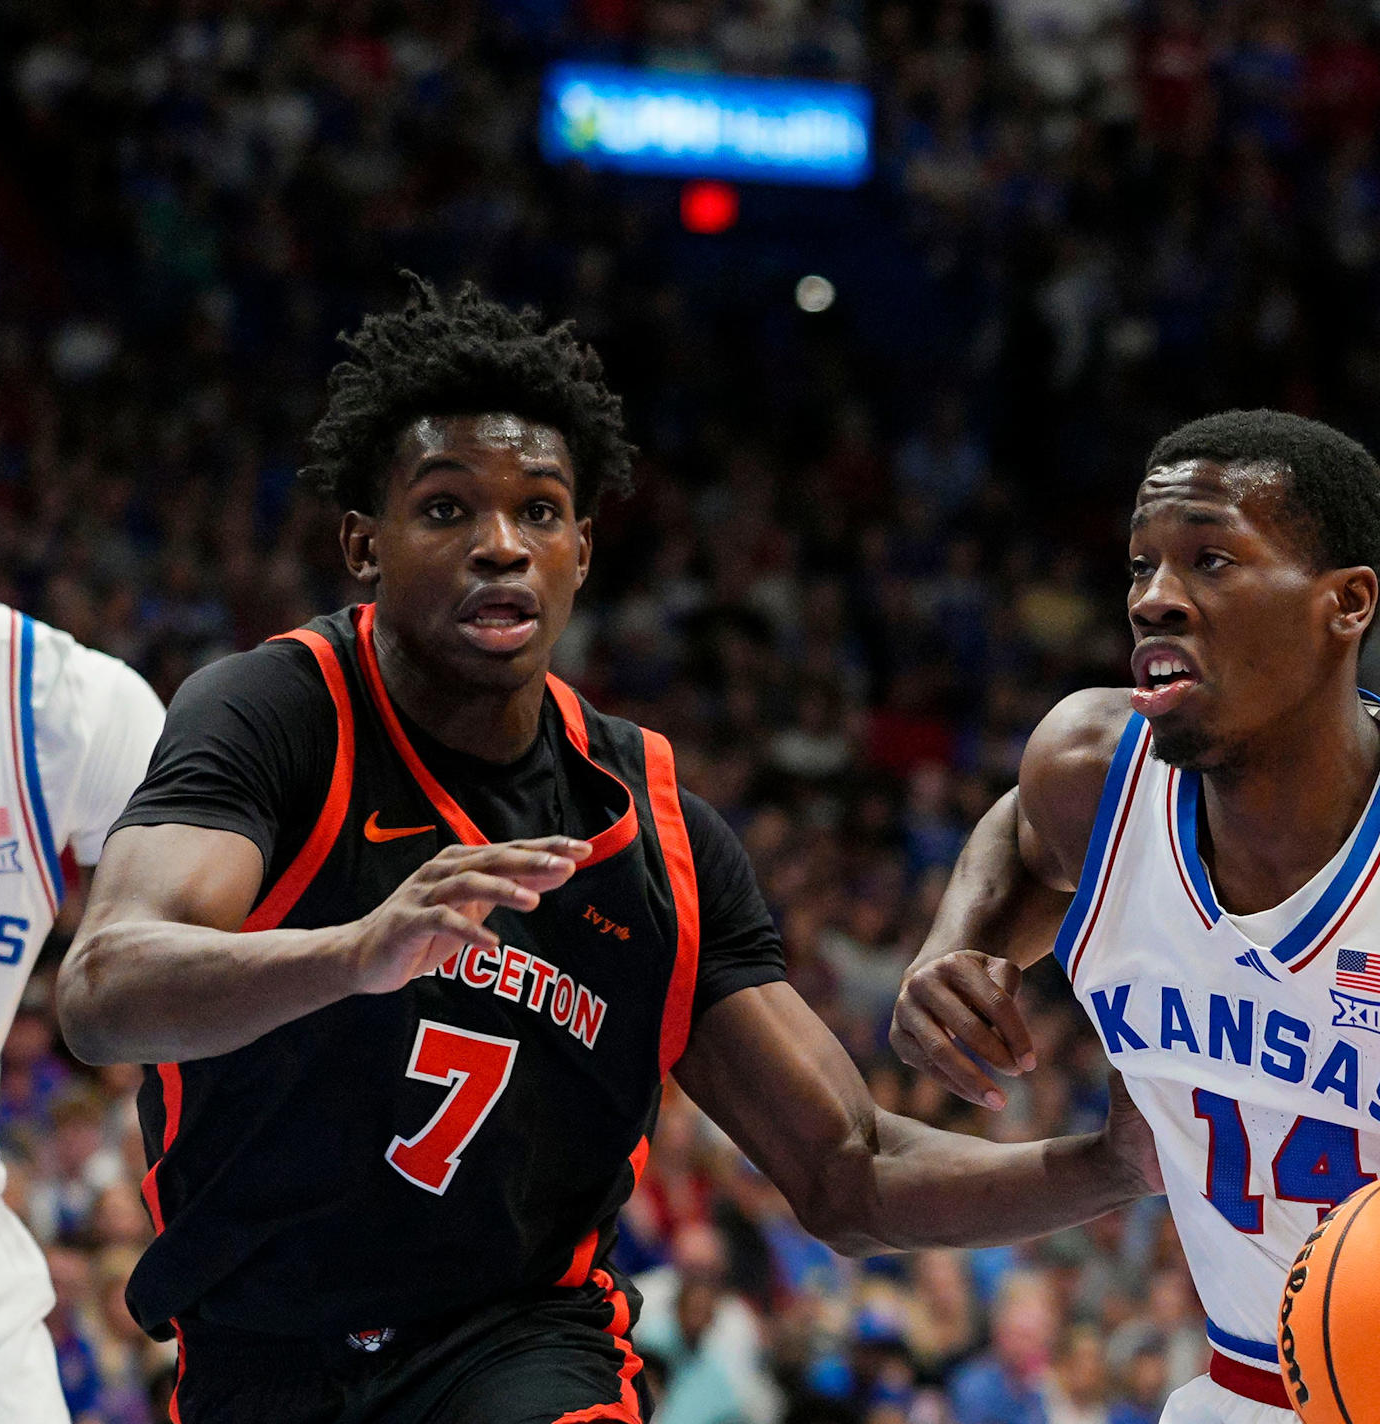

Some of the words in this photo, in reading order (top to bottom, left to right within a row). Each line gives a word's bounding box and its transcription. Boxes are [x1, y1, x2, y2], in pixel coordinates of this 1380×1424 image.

[582, 904, 618, 934] Ivy
[385, 1019, 519, 1197] 7
[1192, 1086, 1378, 1234] 14
